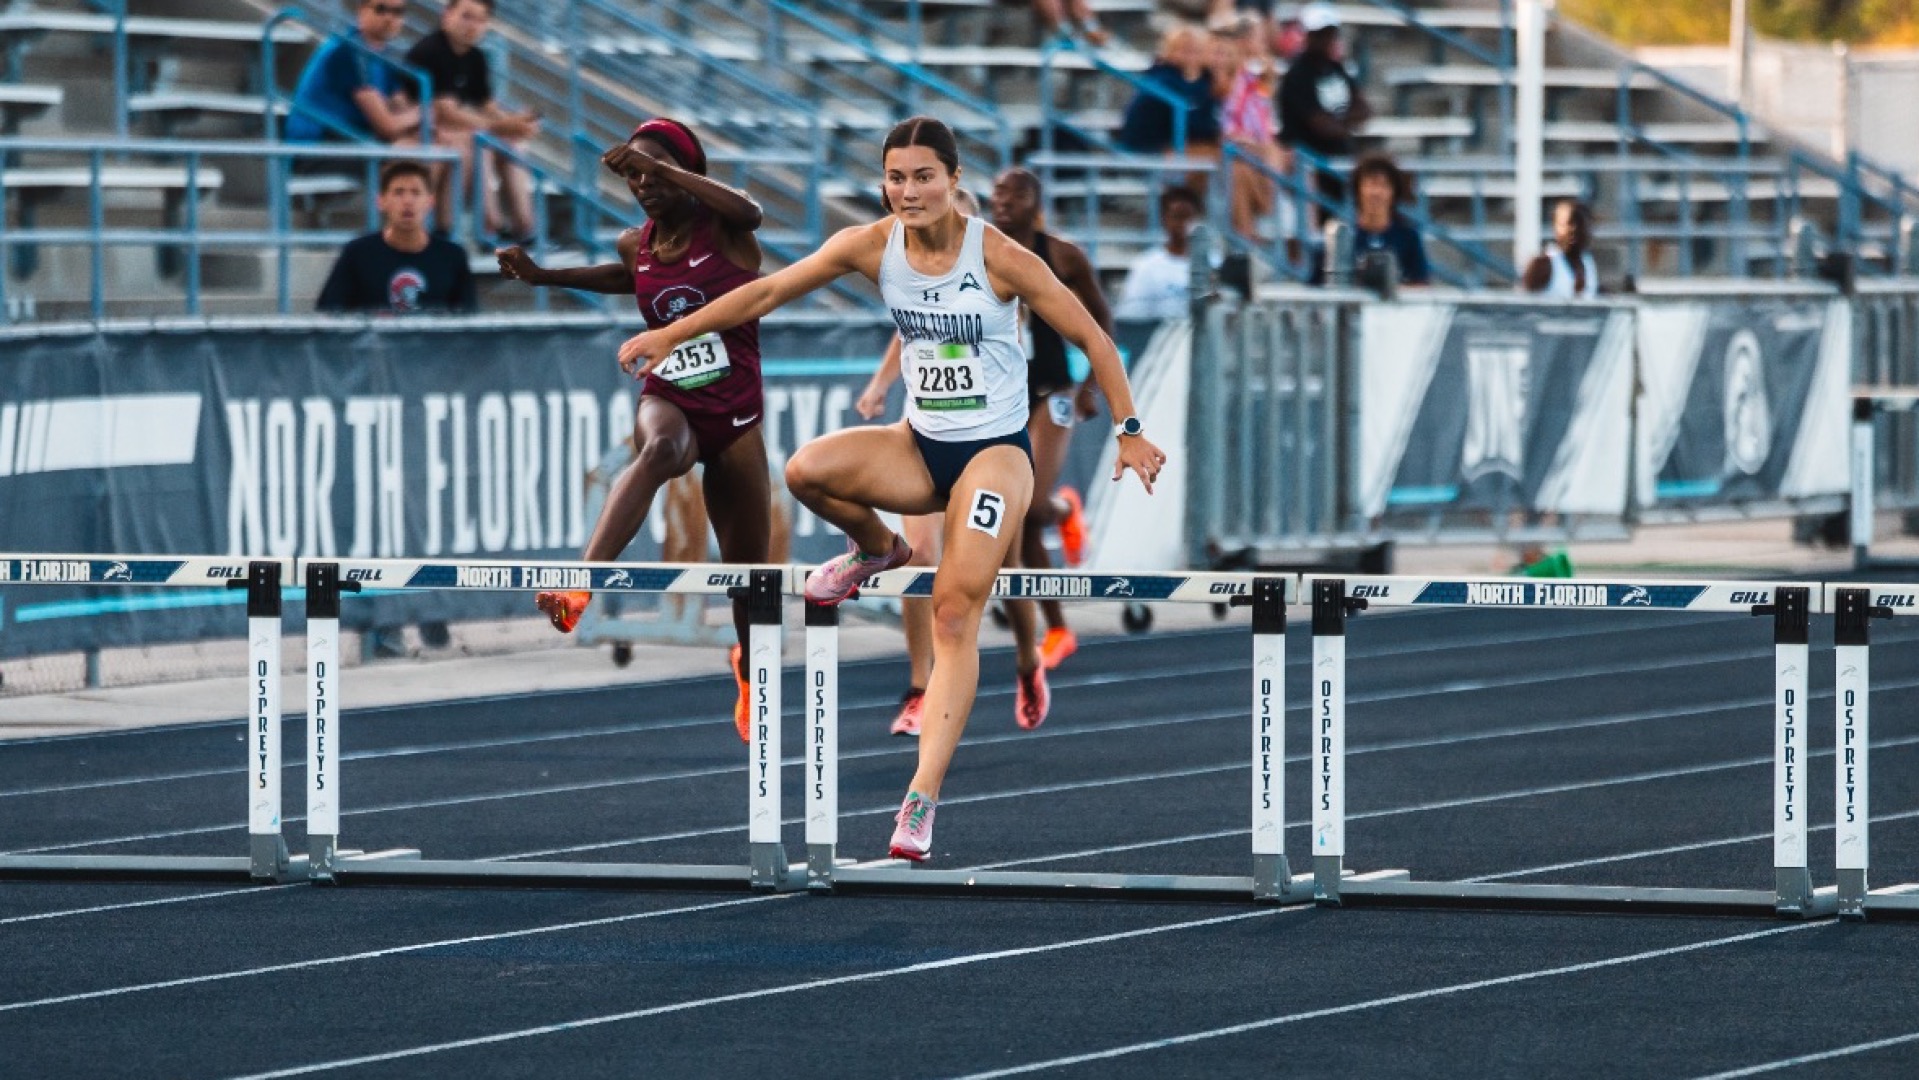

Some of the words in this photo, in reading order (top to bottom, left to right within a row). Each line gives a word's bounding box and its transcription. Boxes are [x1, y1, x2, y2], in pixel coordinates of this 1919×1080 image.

[918, 365, 973, 392] 2283
[226, 395, 404, 557] NORTH
[973, 493, 1000, 529] 5
[21, 560, 90, 581] FLORIDA
[207, 566, 243, 578] GILL
[346, 568, 382, 581] GILL
[456, 566, 512, 587] NORTH
[521, 567, 591, 588] FLORIDA
[707, 573, 744, 587] GILL
[1021, 575, 1092, 596] FLORIDA
[1210, 582, 1247, 595] GILL
[1352, 585, 1390, 598] GILL
[1466, 583, 1525, 604] NORTH
[1533, 584, 1608, 606] FLORIDA
[1730, 592, 1769, 604] GILL
[1876, 594, 1915, 607] GILL
[258, 660, 267, 789] OSPREYS
[316, 661, 326, 790] OSPREYS
[758, 668, 768, 797] OSPREYS
[815, 670, 825, 799] OSPREYS
[1261, 679, 1270, 809] OSPREYS
[1321, 680, 1330, 810] OSPREYS
[1785, 689, 1794, 821] OSPREYS
[1845, 690, 1855, 821] OSPREYS
